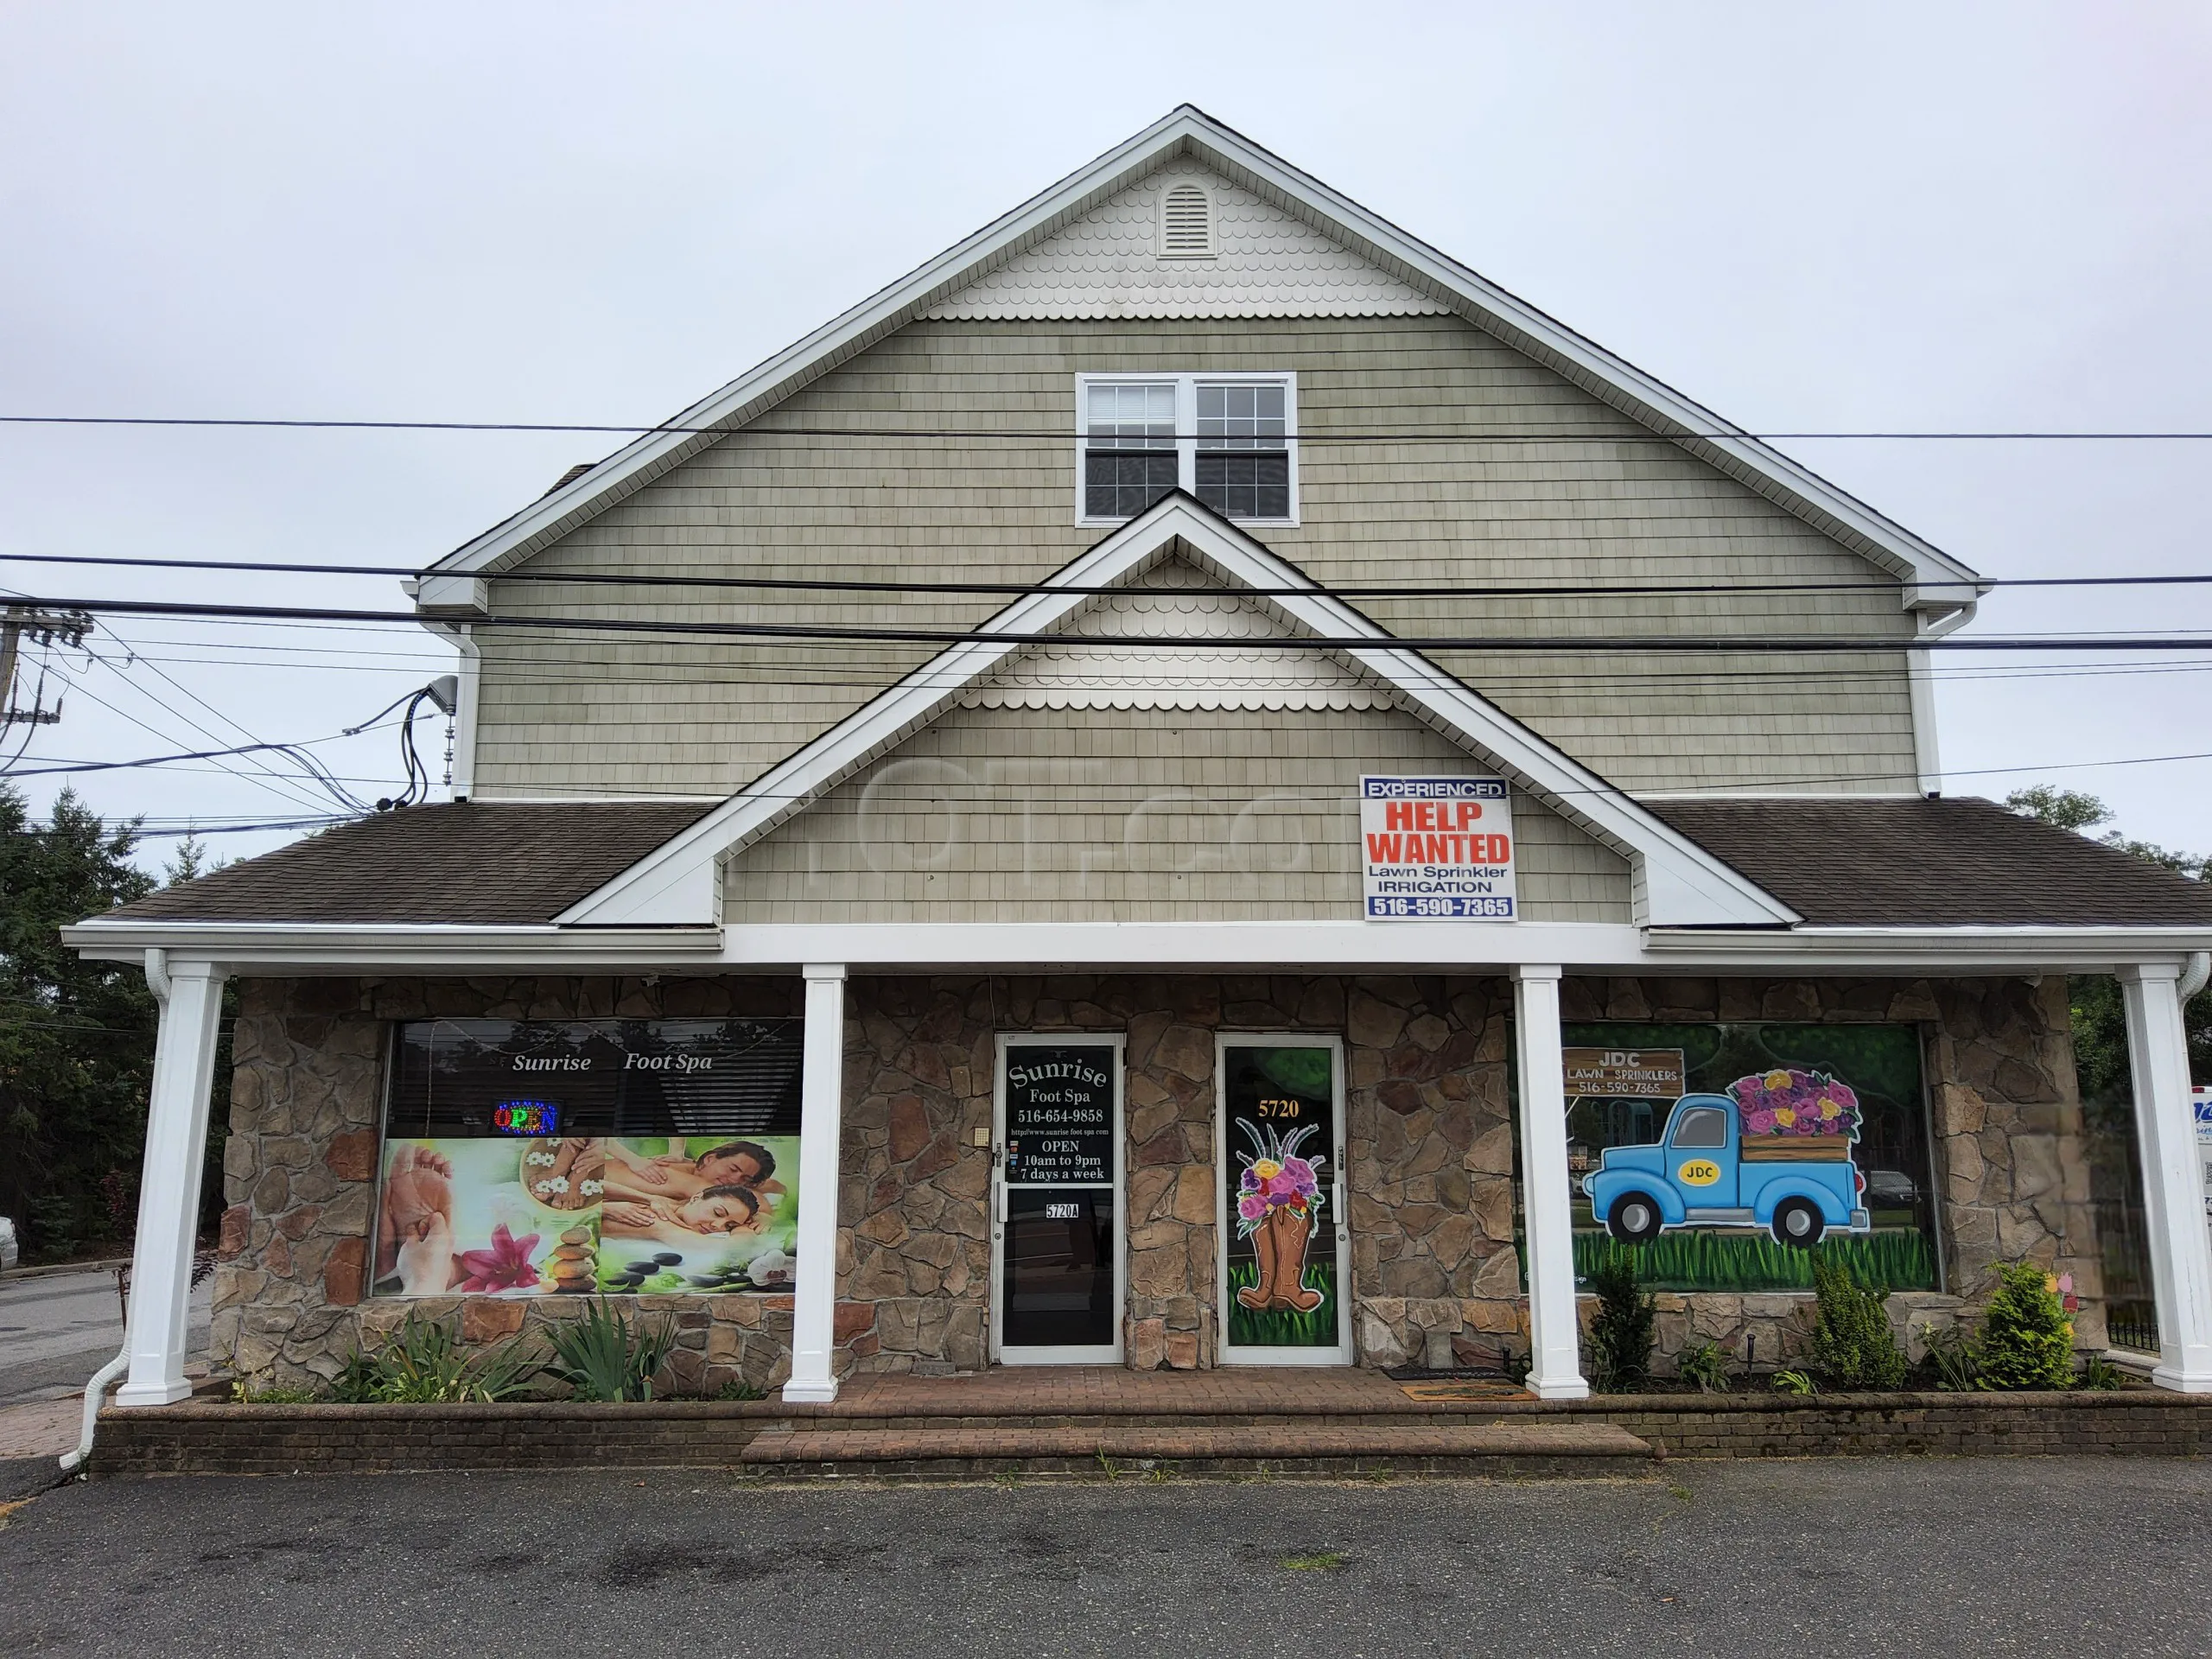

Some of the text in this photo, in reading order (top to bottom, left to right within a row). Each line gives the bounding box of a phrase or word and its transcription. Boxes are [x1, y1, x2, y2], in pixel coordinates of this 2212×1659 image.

[1368, 782, 1503, 797] EXPERIENCED
[1386, 802, 1482, 831] HELP
[1366, 834, 1510, 864] WANTED
[1369, 866, 1508, 880] Lawn Sprinkler
[1378, 881, 1492, 893] IRRIGATION
[1374, 898, 1509, 916] 516-590-7365
[512, 1053, 713, 1073] Sunrise Foot Spa
[1599, 1052, 1641, 1067] JDC
[1008, 1058, 1107, 1090] Sunrise
[1567, 1068, 1677, 1081] LAWN SPRINKLERS
[1579, 1082, 1661, 1093] 516-590-7365
[1030, 1089, 1091, 1105] Foot Spa
[1018, 1109, 1103, 1123] 516-654-9858
[1258, 1100, 1300, 1117] 5720
[494, 1109, 556, 1131] OPEN
[1042, 1141, 1080, 1153] OPEN
[1024, 1155, 1056, 1166] 10am
[1059, 1156, 1071, 1166] to
[1075, 1155, 1102, 1169] 9pm
[1020, 1168, 1027, 1179] 7
[1030, 1167, 1058, 1183] days
[1062, 1171, 1069, 1179] a
[1073, 1167, 1105, 1179] week
[1687, 1166, 1713, 1179] JDC
[1047, 1205, 1078, 1218] 5720A
